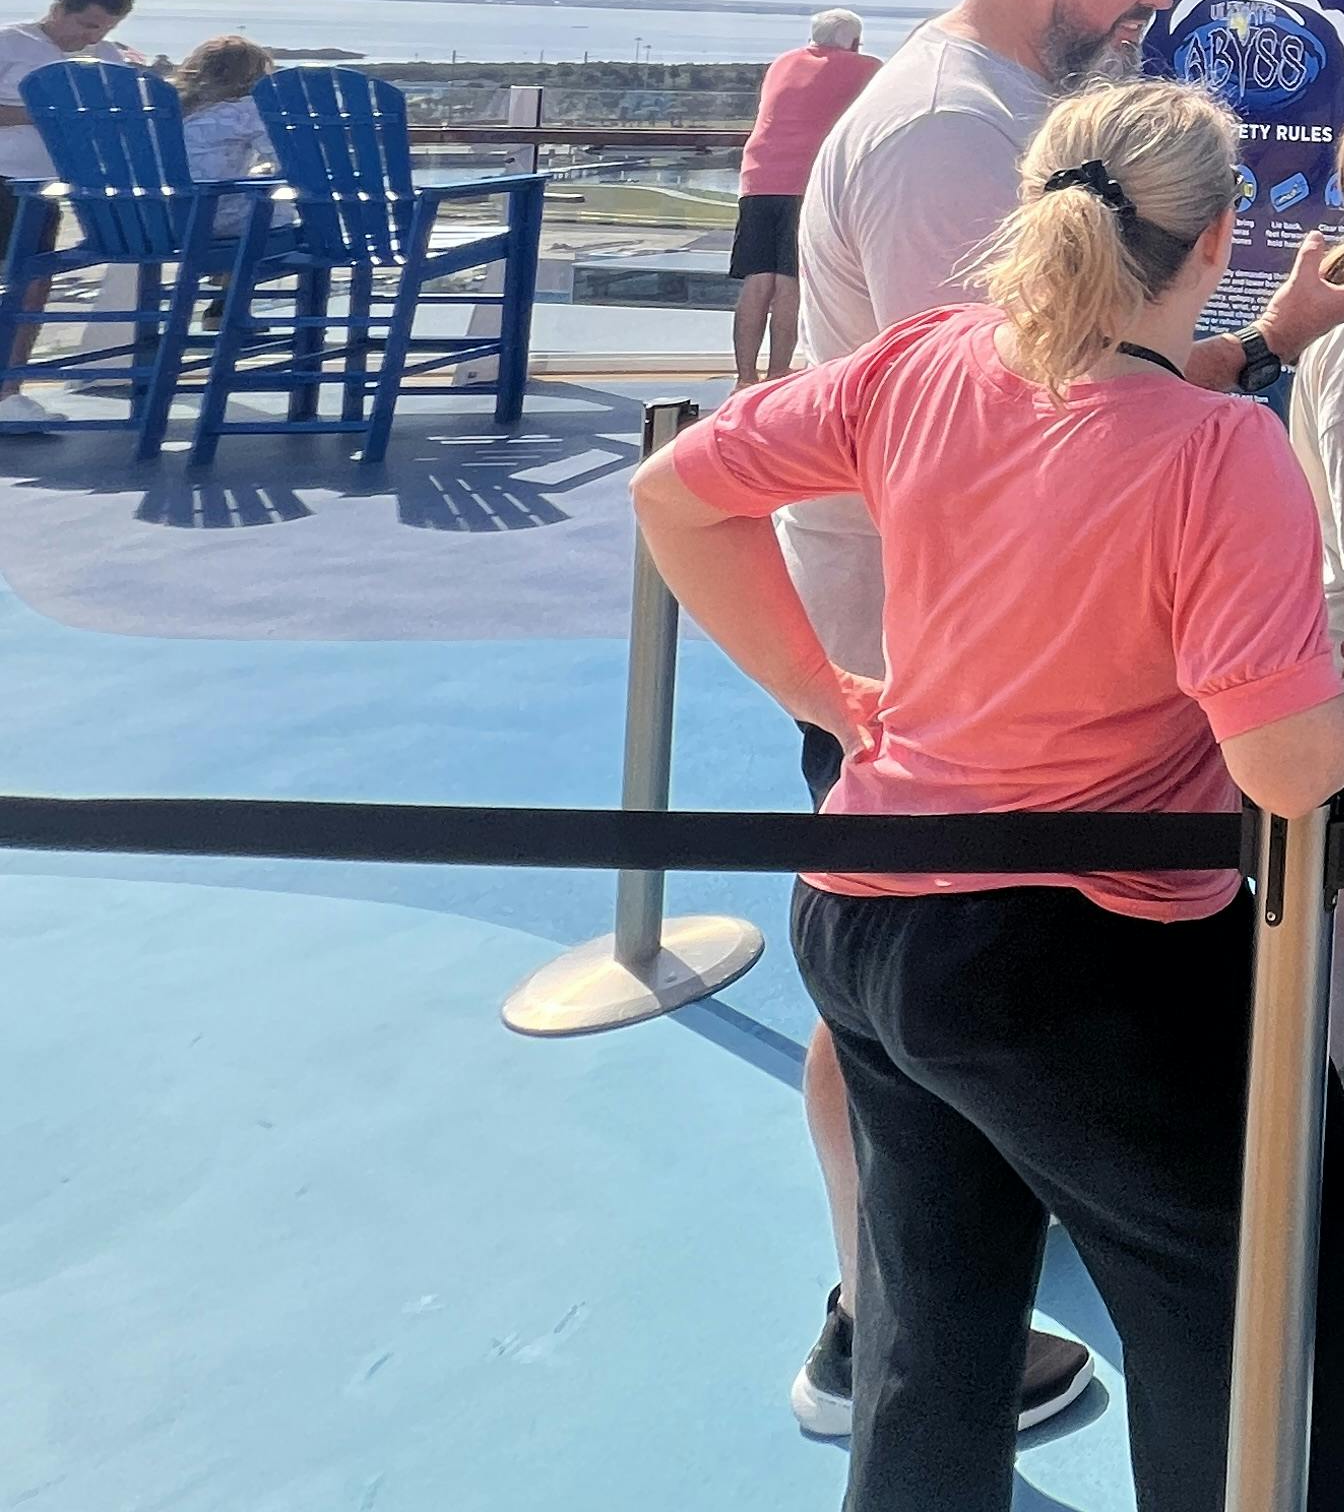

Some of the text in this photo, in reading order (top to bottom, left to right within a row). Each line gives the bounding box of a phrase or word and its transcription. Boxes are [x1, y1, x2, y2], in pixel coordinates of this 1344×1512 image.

[1184, 27, 1307, 98] ABYSS
[1237, 123, 1333, 143] ETY RULES
